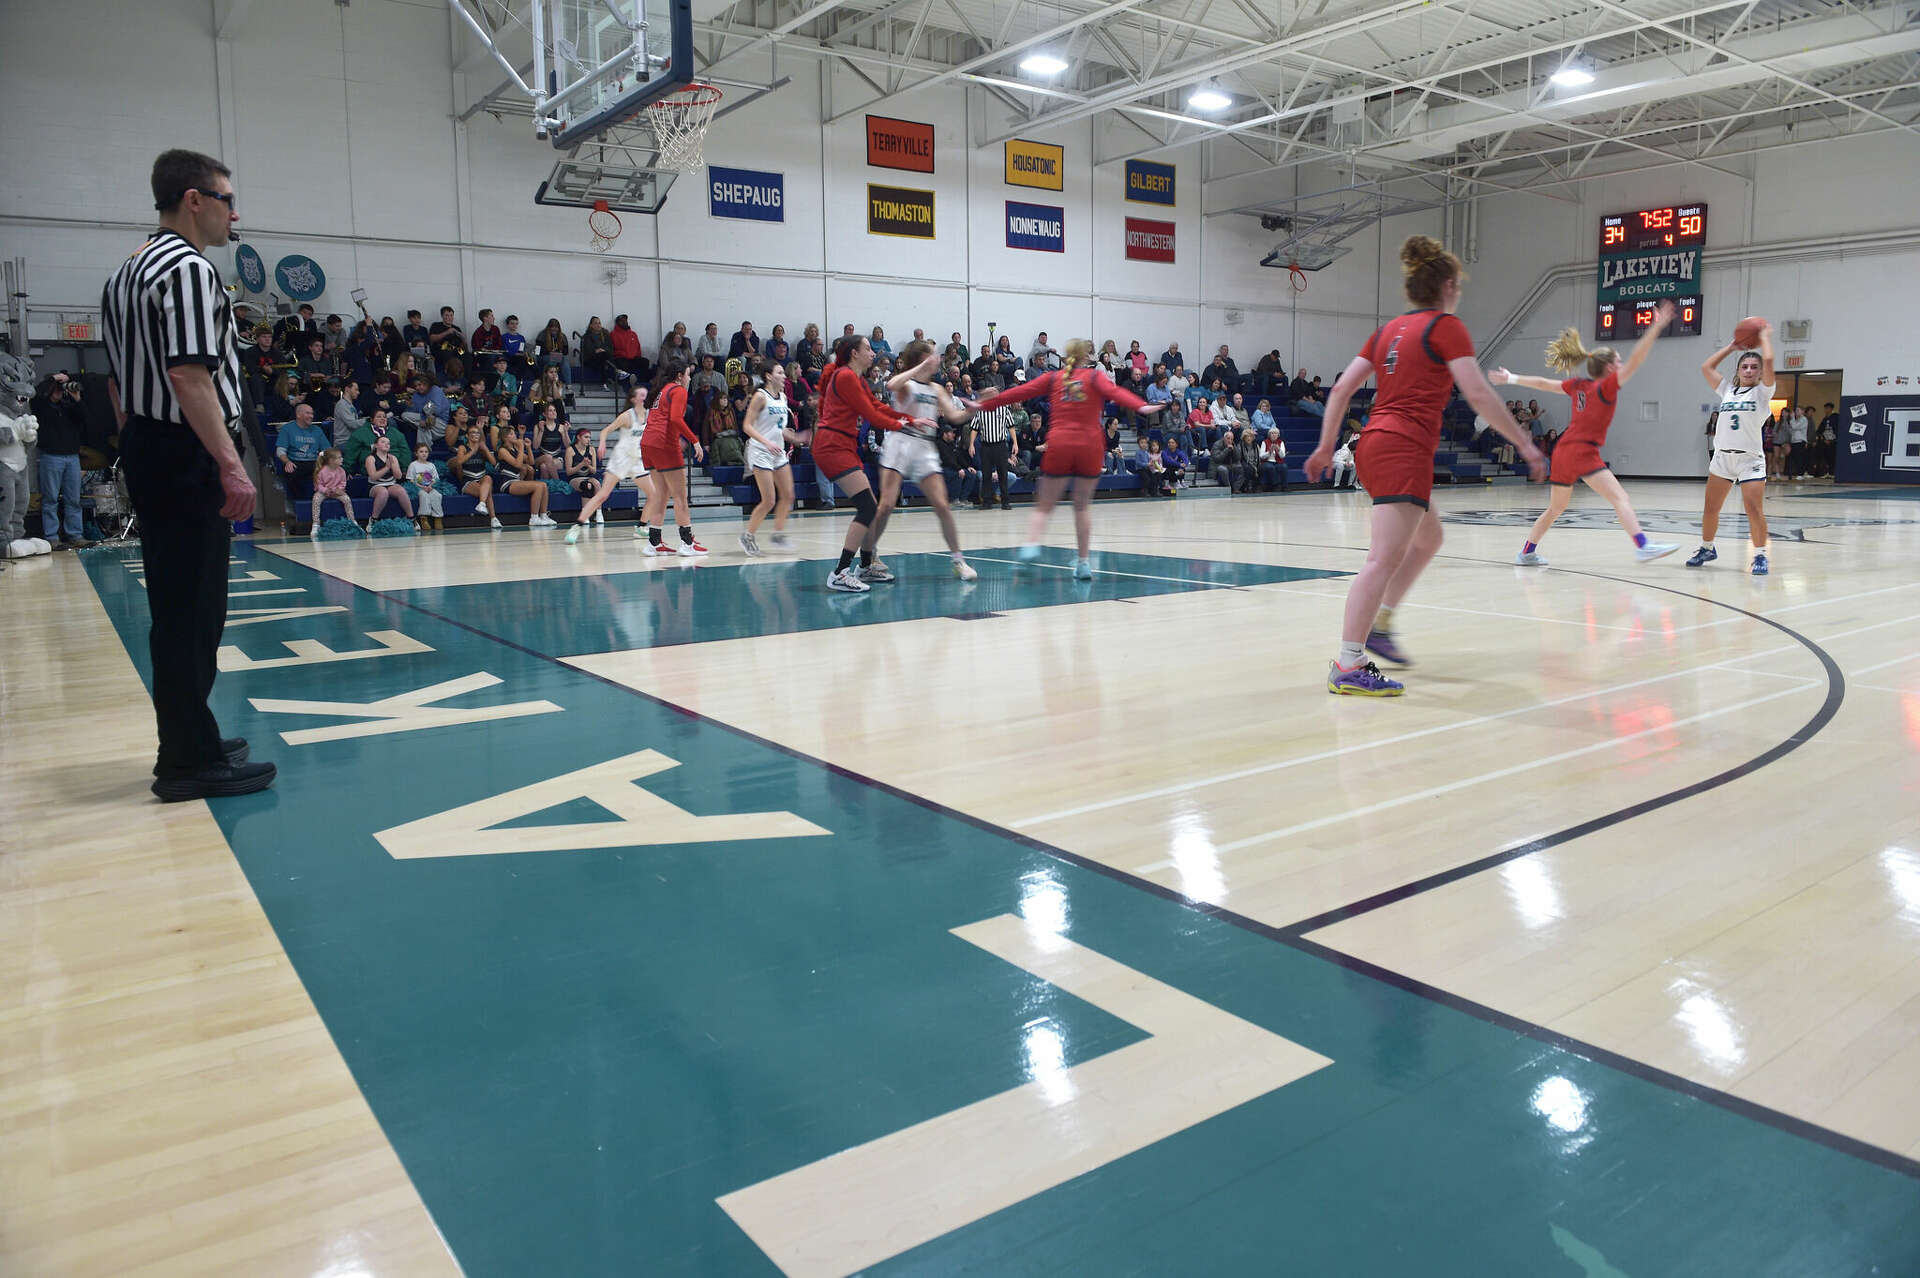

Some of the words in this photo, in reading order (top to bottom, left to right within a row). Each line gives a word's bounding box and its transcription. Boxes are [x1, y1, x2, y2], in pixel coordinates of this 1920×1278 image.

[873, 131, 929, 157] TERRYVILLE
[1012, 153, 1056, 175] HOUSATONIC
[1130, 172, 1171, 193] GILBERT
[713, 182, 781, 207] SHEPAUG
[872, 199, 931, 223] THOMASTON
[1639, 209, 1673, 228] 7:52
[1009, 215, 1061, 238] NONNEWAUG
[1604, 226, 1624, 244] 34
[1680, 216, 1701, 235] 50
[1127, 230, 1176, 251] NORTHWESTERN
[1664, 234, 1673, 245] 4
[1602, 251, 1696, 288] LAKEVIEW
[1620, 282, 1676, 296] BOBCATS
[1603, 314, 1612, 327] 0
[1684, 308, 1693, 321] 0
[69, 325, 89, 338] EXIT
[1730, 414, 1740, 431] 3
